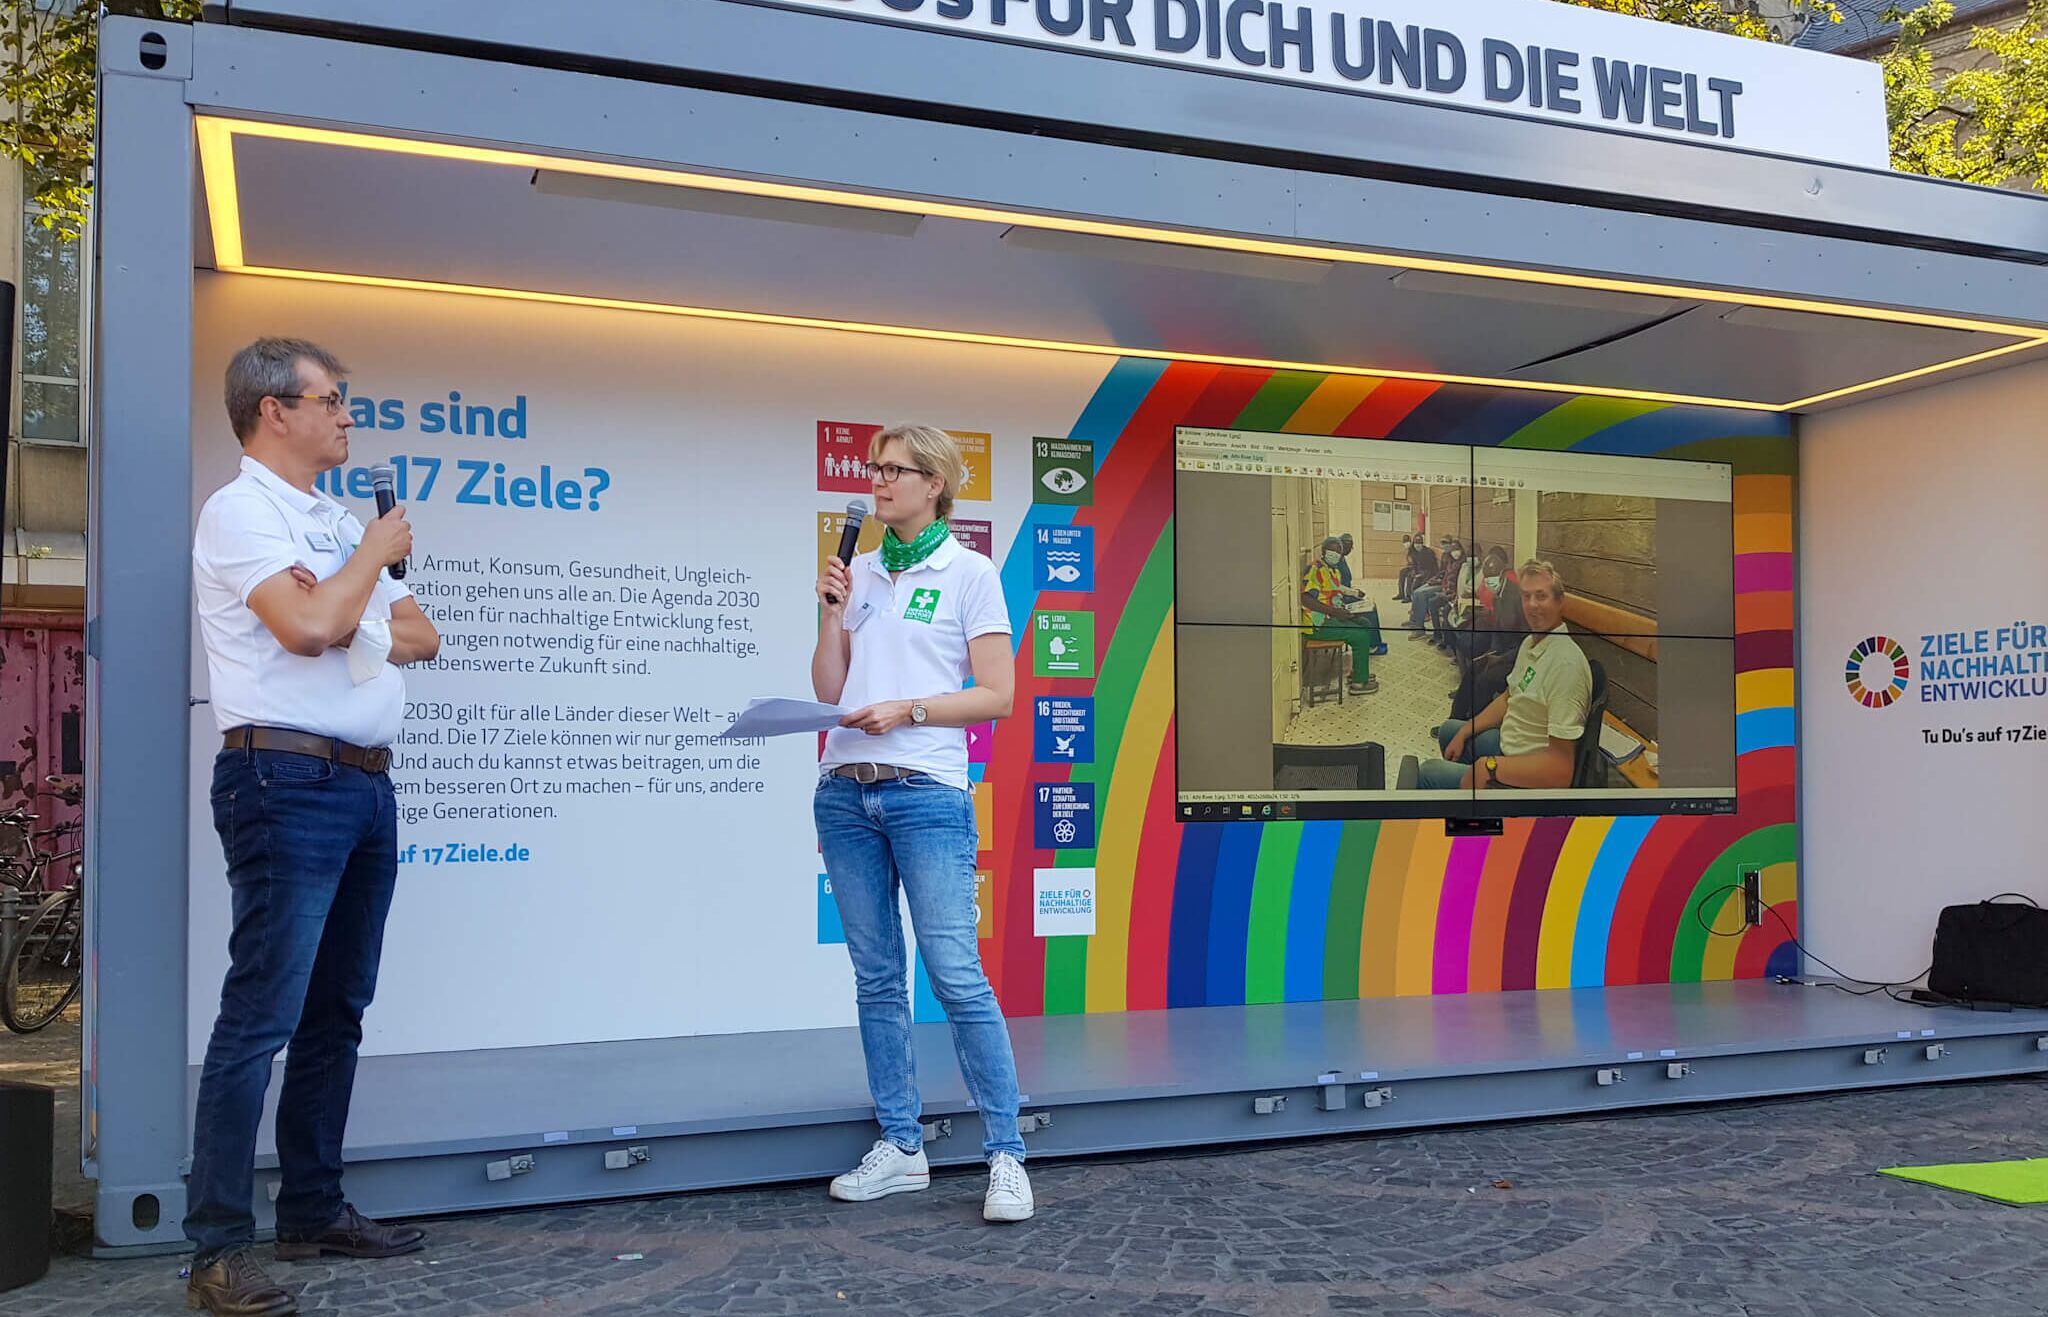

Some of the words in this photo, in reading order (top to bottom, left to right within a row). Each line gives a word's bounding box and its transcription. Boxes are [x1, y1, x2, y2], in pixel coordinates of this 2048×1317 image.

[1154, 0, 1314, 73] DICH
[1331, 12, 1467, 94] UND
[1483, 38, 1582, 114] DIE
[1593, 56, 1743, 139] WELT
[337, 382, 405, 431] as
[420, 391, 527, 439] sind
[825, 426, 830, 443] 1
[1036, 441, 1048, 458] 13
[390, 455, 442, 501] 17
[456, 459, 610, 512] Ziele?
[824, 516, 832, 533] 2
[1037, 528, 1049, 544] 14
[423, 553, 485, 575] Armut,
[490, 557, 564, 579] Konsum,
[569, 560, 671, 583] Gesundheit,
[675, 565, 752, 588] Ungleich-
[465, 581, 519, 602] gehen
[524, 587, 553, 600] uns
[558, 584, 588, 602] alle
[592, 590, 616, 602] an.
[620, 586, 648, 604] Die
[651, 588, 713, 610] Agenda
[716, 590, 760, 608] 2030
[478, 605, 504, 623] für
[509, 607, 609, 631] nachhaltige
[614, 610, 714, 634] Entwicklung
[717, 613, 753, 633] fest,
[1037, 614, 1049, 630] 15
[504, 633, 595, 655] notwendig
[598, 633, 622, 650] für
[626, 636, 661, 652] eine
[664, 636, 760, 658] nachhaltige,
[1920, 630, 1989, 657] ZIELE
[1996, 620, 2048, 651] FÜR
[539, 656, 608, 674] Zukunft
[612, 658, 652, 675] sind.
[1920, 677, 2047, 702] ENTWICKLU
[403, 702, 452, 720] 2030
[456, 702, 485, 725] gilt
[490, 703, 516, 721] für
[520, 704, 551, 721] alle
[555, 704, 614, 722] Länder
[618, 705, 670, 722] dieser
[673, 706, 711, 723] Welt
[1038, 700, 1050, 717] 16
[448, 728, 477, 746] Die
[481, 728, 499, 745] 17
[504, 728, 547, 745] Ziele
[551, 729, 612, 746] können
[615, 731, 641, 746] wir
[645, 734, 671, 746] nur
[674, 731, 766, 751] gemeinsam
[1922, 729, 1939, 744] Tu
[1977, 726, 2003, 743] auf
[391, 752, 428, 770] Und
[432, 753, 473, 770] auch
[478, 753, 499, 770] du
[504, 753, 563, 770] kannst
[567, 755, 618, 770] etwas
[622, 753, 704, 774] beitragen,
[708, 758, 733, 770] um
[736, 754, 761, 770] die
[425, 778, 506, 795] besseren
[510, 777, 539, 794] Ort
[543, 782, 562, 794] zu
[566, 778, 631, 794] machen
[648, 777, 672, 793] für
[676, 781, 706, 795] uns,
[709, 777, 765, 793] andere
[1039, 786, 1050, 803] 17
[433, 802, 558, 820] Generationen.
[422, 842, 530, 866] 17Ziele.de
[1040, 890, 1063, 899] ZIELE
[1065, 888, 1081, 898] FÜR
[1040, 898, 1092, 907] NACHHALTIGE
[1040, 907, 1092, 915] ENTWICKLUNG
